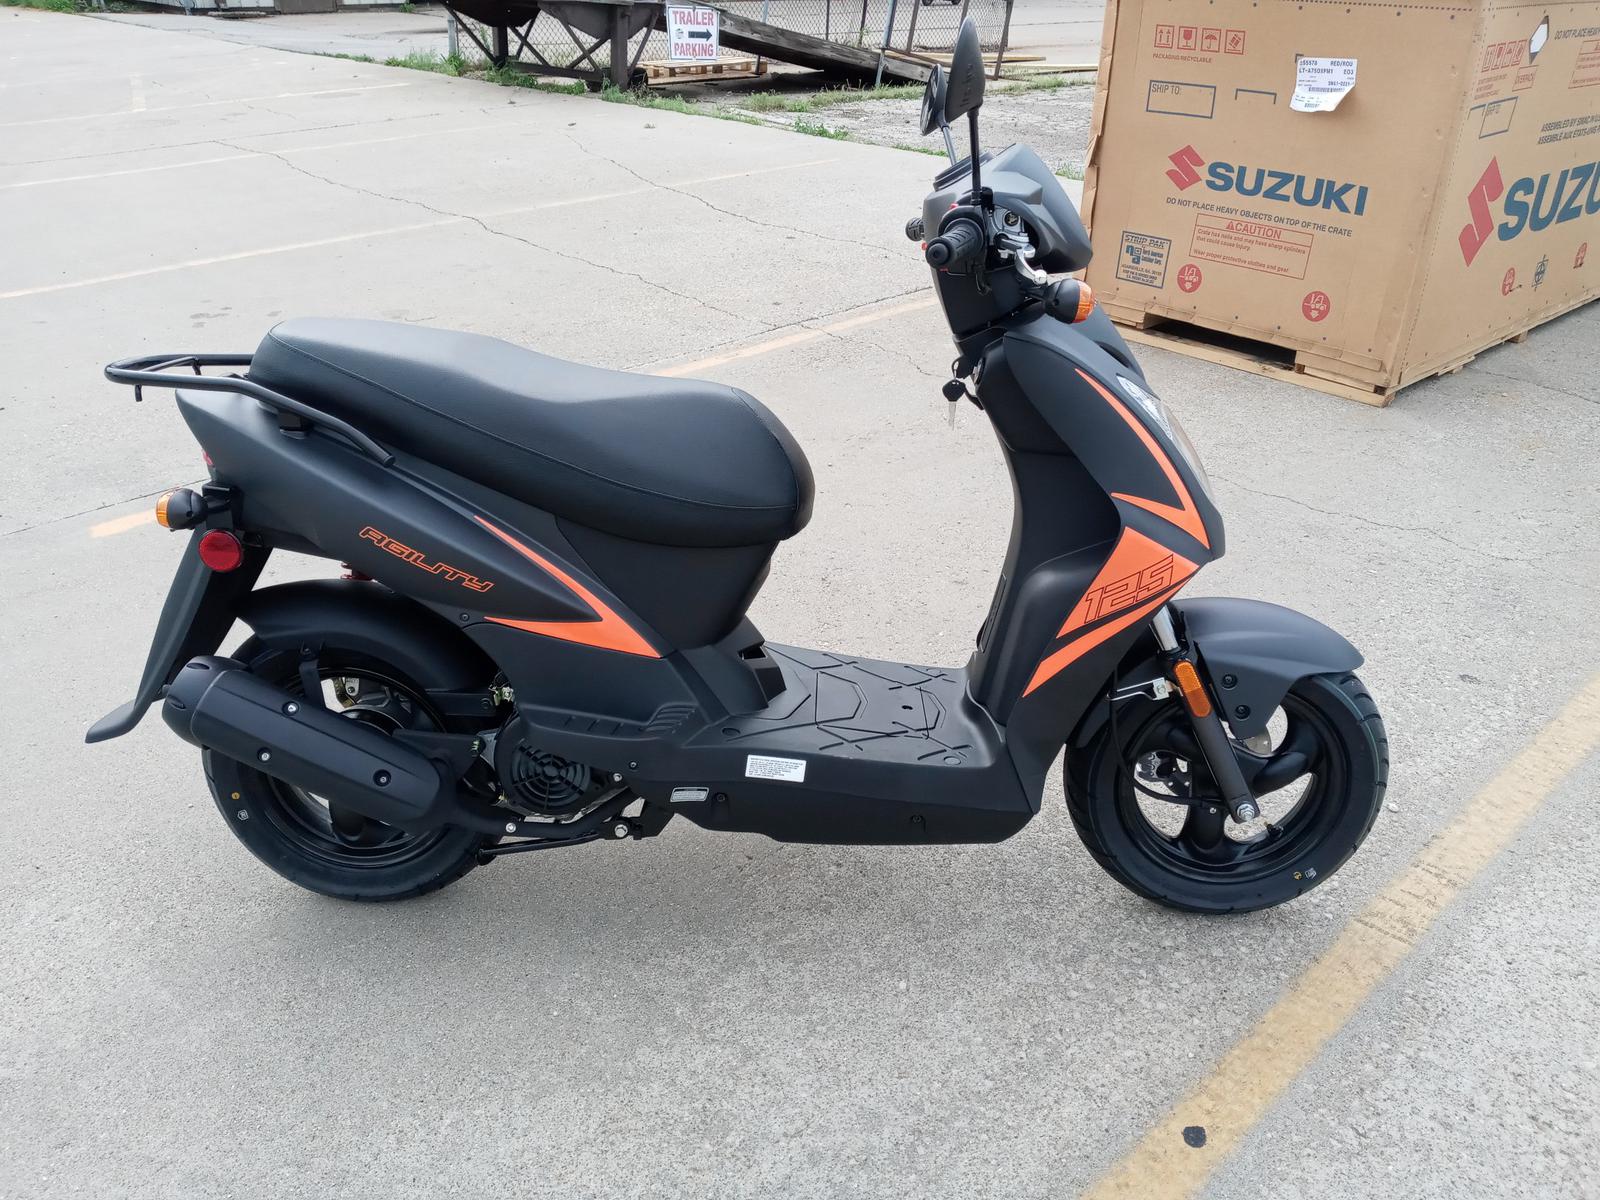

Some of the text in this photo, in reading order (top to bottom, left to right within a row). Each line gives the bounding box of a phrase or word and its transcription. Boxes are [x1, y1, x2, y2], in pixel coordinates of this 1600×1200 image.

[672, 10, 714, 26] TRAILER
[673, 42, 714, 57] PARKING
[1180, 55, 1212, 64] RECYCLABLE
[1151, 83, 1169, 94] SHIP
[1205, 161, 1369, 216] SUZUKI
[1166, 196, 1352, 238] DO NOT PLACE HEAVY OBJECTS ON TOP OF THE CRATE
[1235, 222, 1282, 239] CAUTION
[359, 526, 496, 593] AGILITY
[1084, 553, 1174, 624] 125
